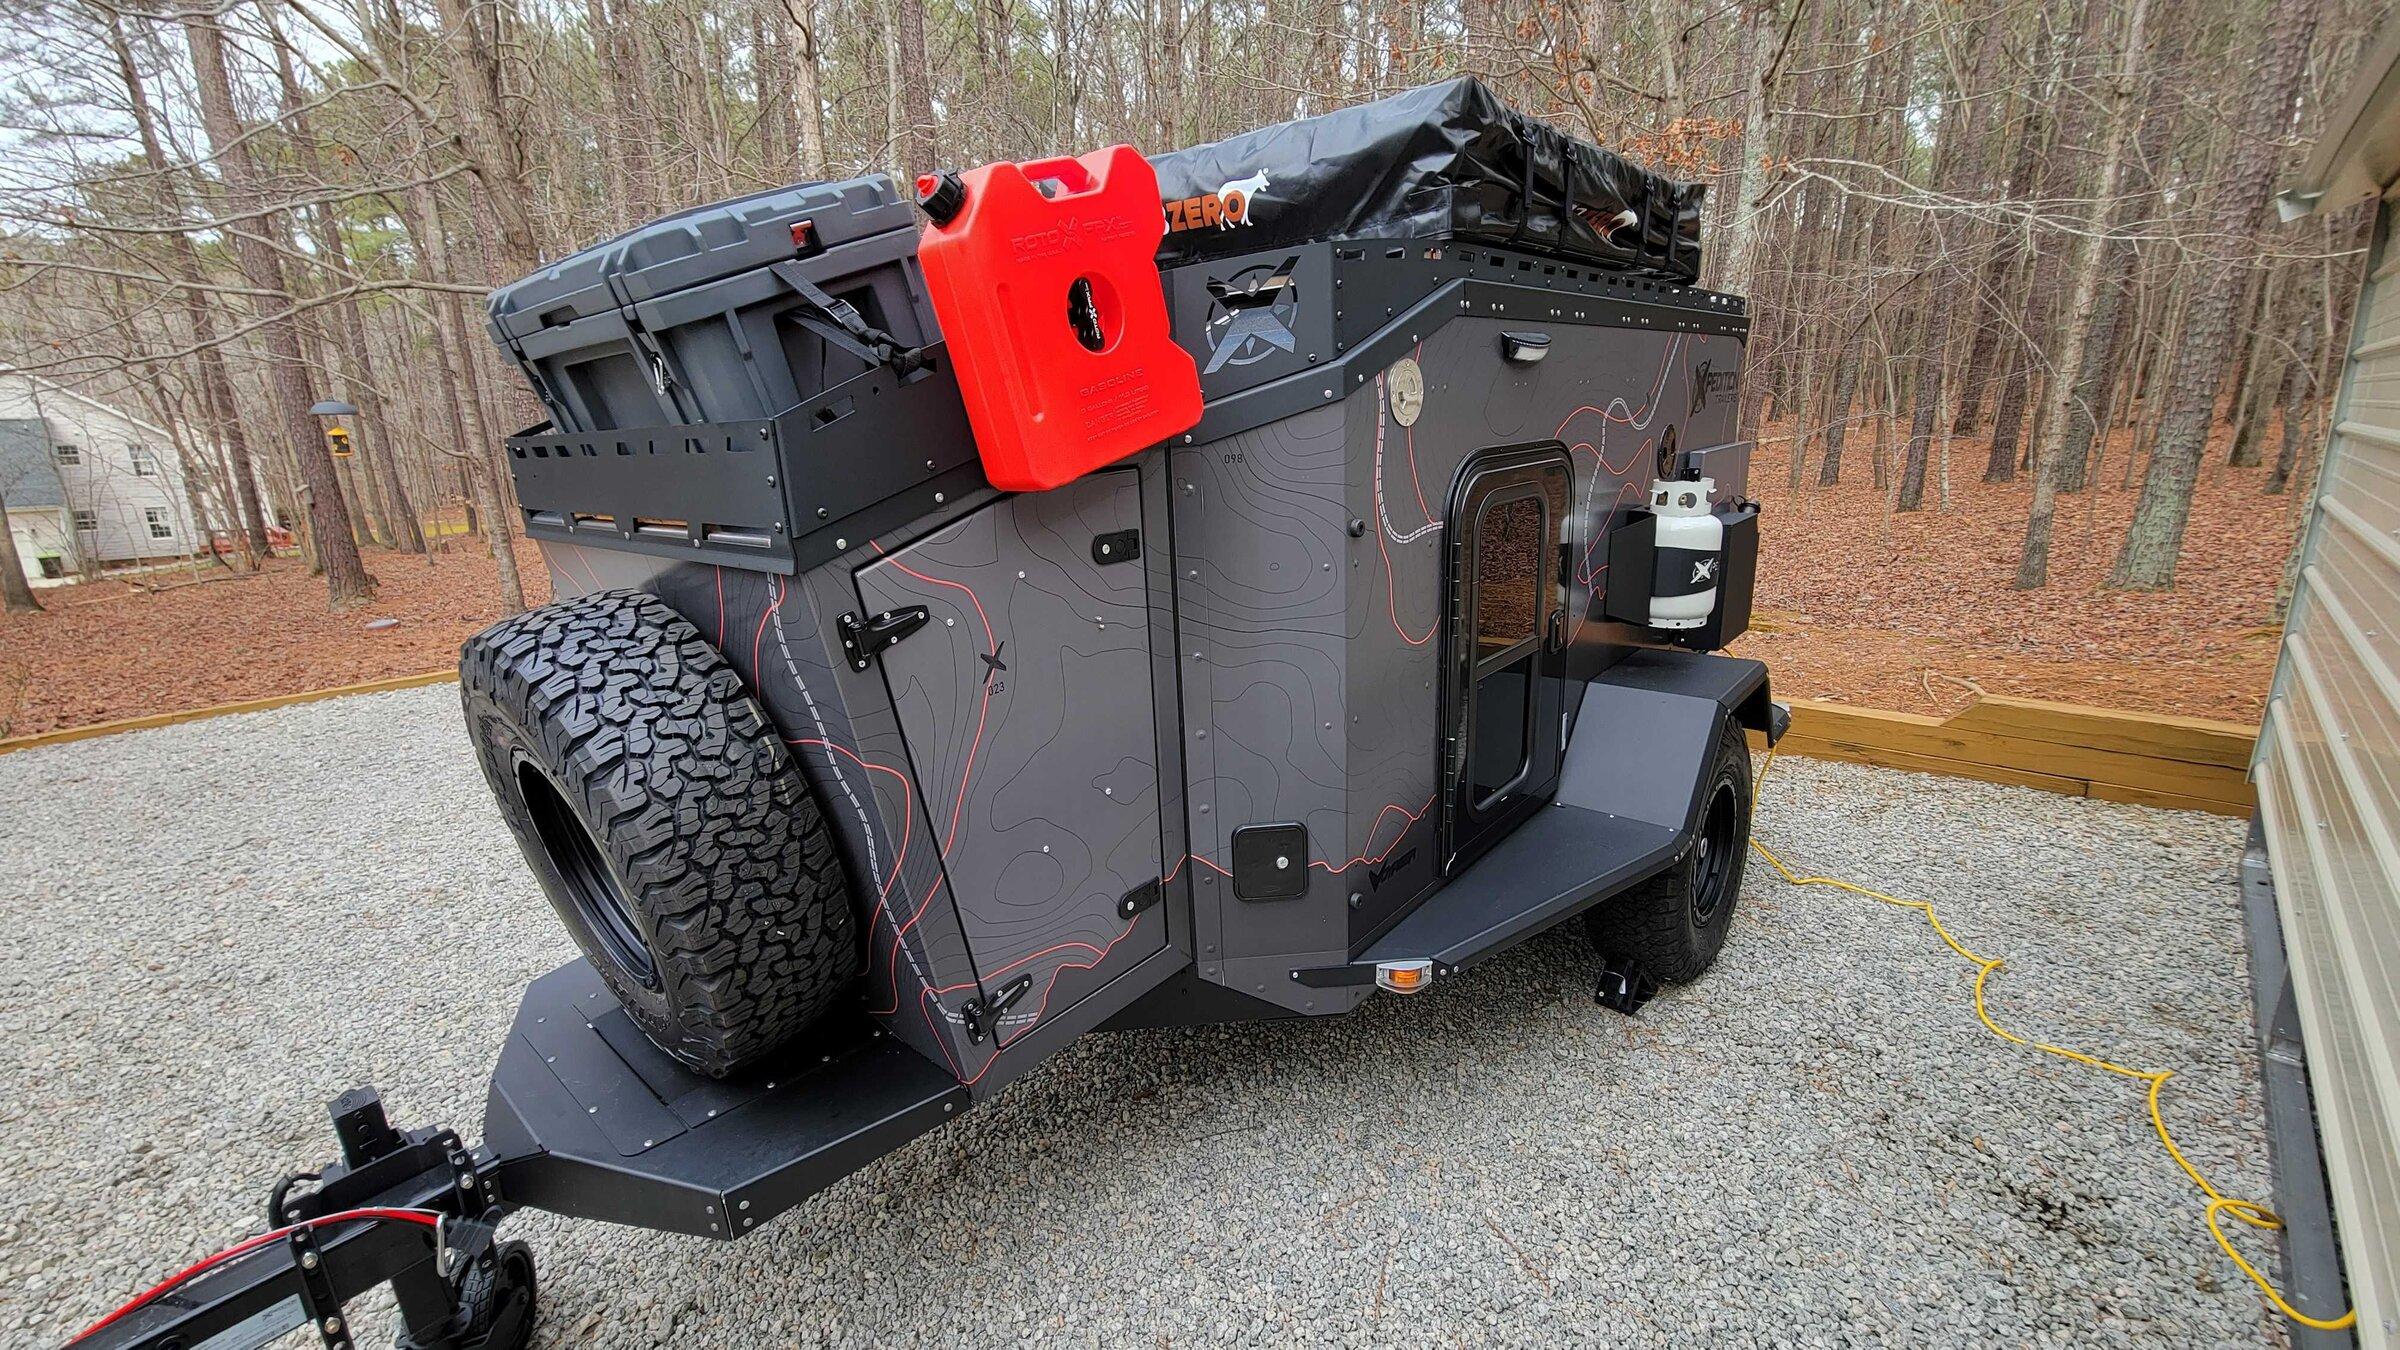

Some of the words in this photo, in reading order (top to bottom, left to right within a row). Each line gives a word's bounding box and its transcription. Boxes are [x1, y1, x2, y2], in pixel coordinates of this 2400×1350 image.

[1162, 190, 1246, 236] ZERO
[1224, 453, 1243, 464] 098
[987, 681, 1005, 697] 023
